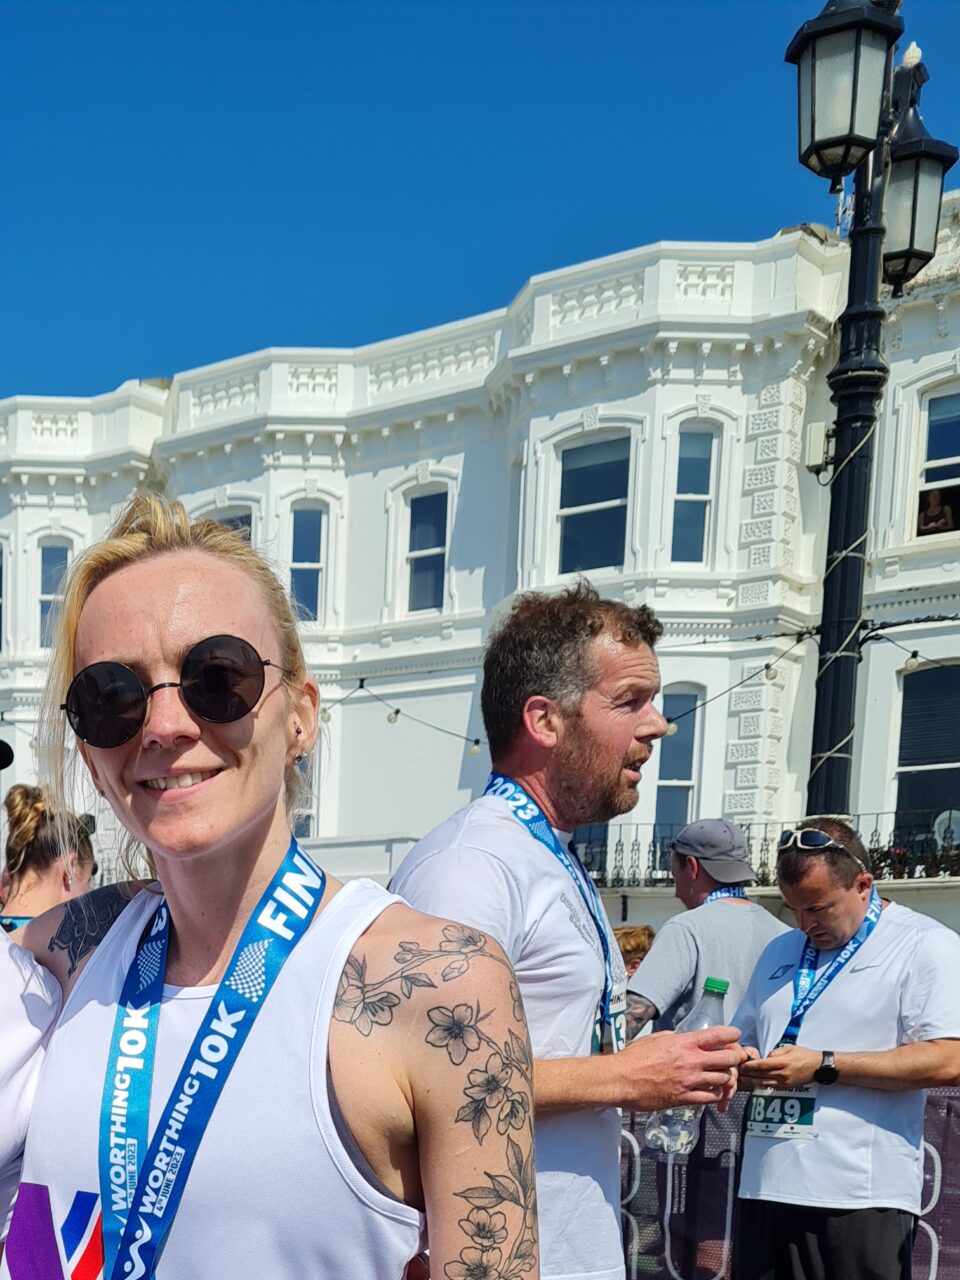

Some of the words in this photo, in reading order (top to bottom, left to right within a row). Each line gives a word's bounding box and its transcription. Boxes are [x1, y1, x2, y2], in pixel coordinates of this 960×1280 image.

[116, 1000, 151, 1071] 10K
[139, 1077, 201, 1215] WORTHING
[191, 1000, 248, 1081] 10K
[751, 1097, 801, 1124] 1849
[109, 1073, 132, 1212] WORTHING
[127, 1143, 136, 1165] 2023
[161, 1176, 174, 1199] JUNE
[171, 1151, 183, 1175] 2023
